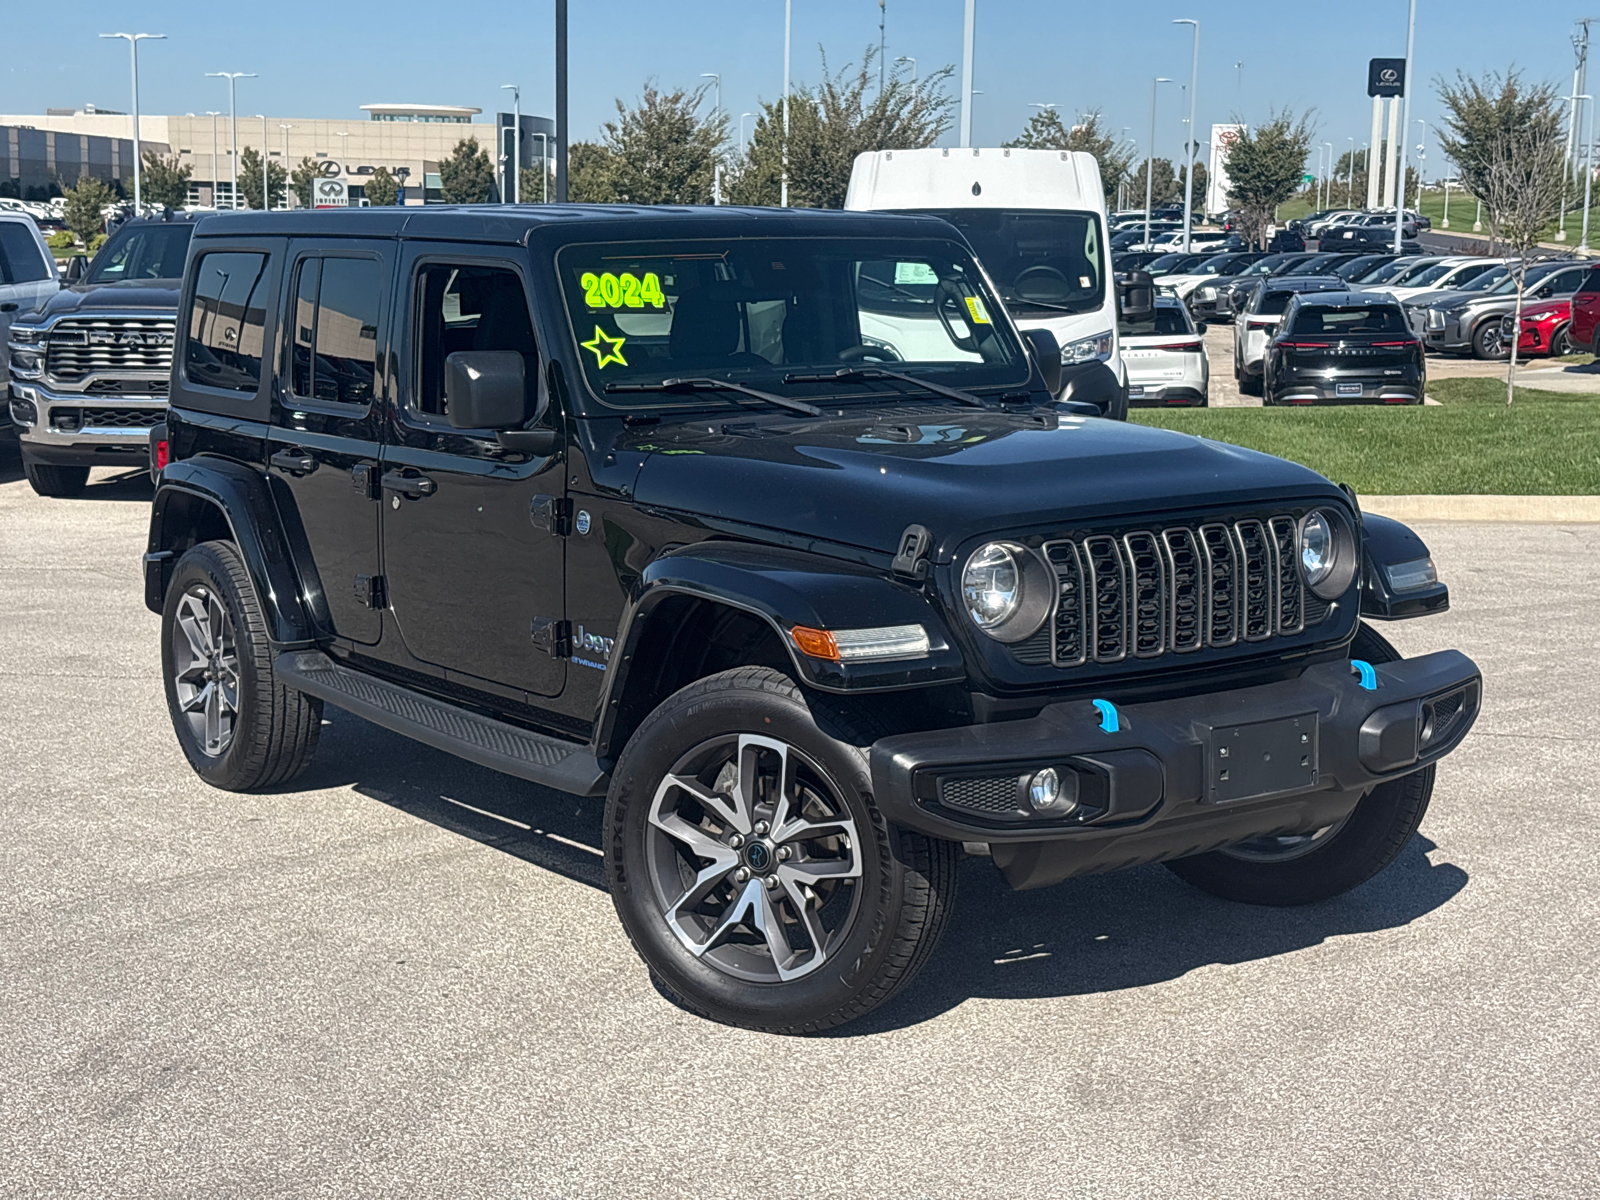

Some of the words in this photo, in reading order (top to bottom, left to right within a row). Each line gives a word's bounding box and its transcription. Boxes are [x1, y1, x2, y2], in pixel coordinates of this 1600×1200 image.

[581, 272, 666, 308] 2024
[88, 331, 175, 346] RAM
[572, 625, 614, 661] Jeep
[612, 784, 634, 883] NEXEN
